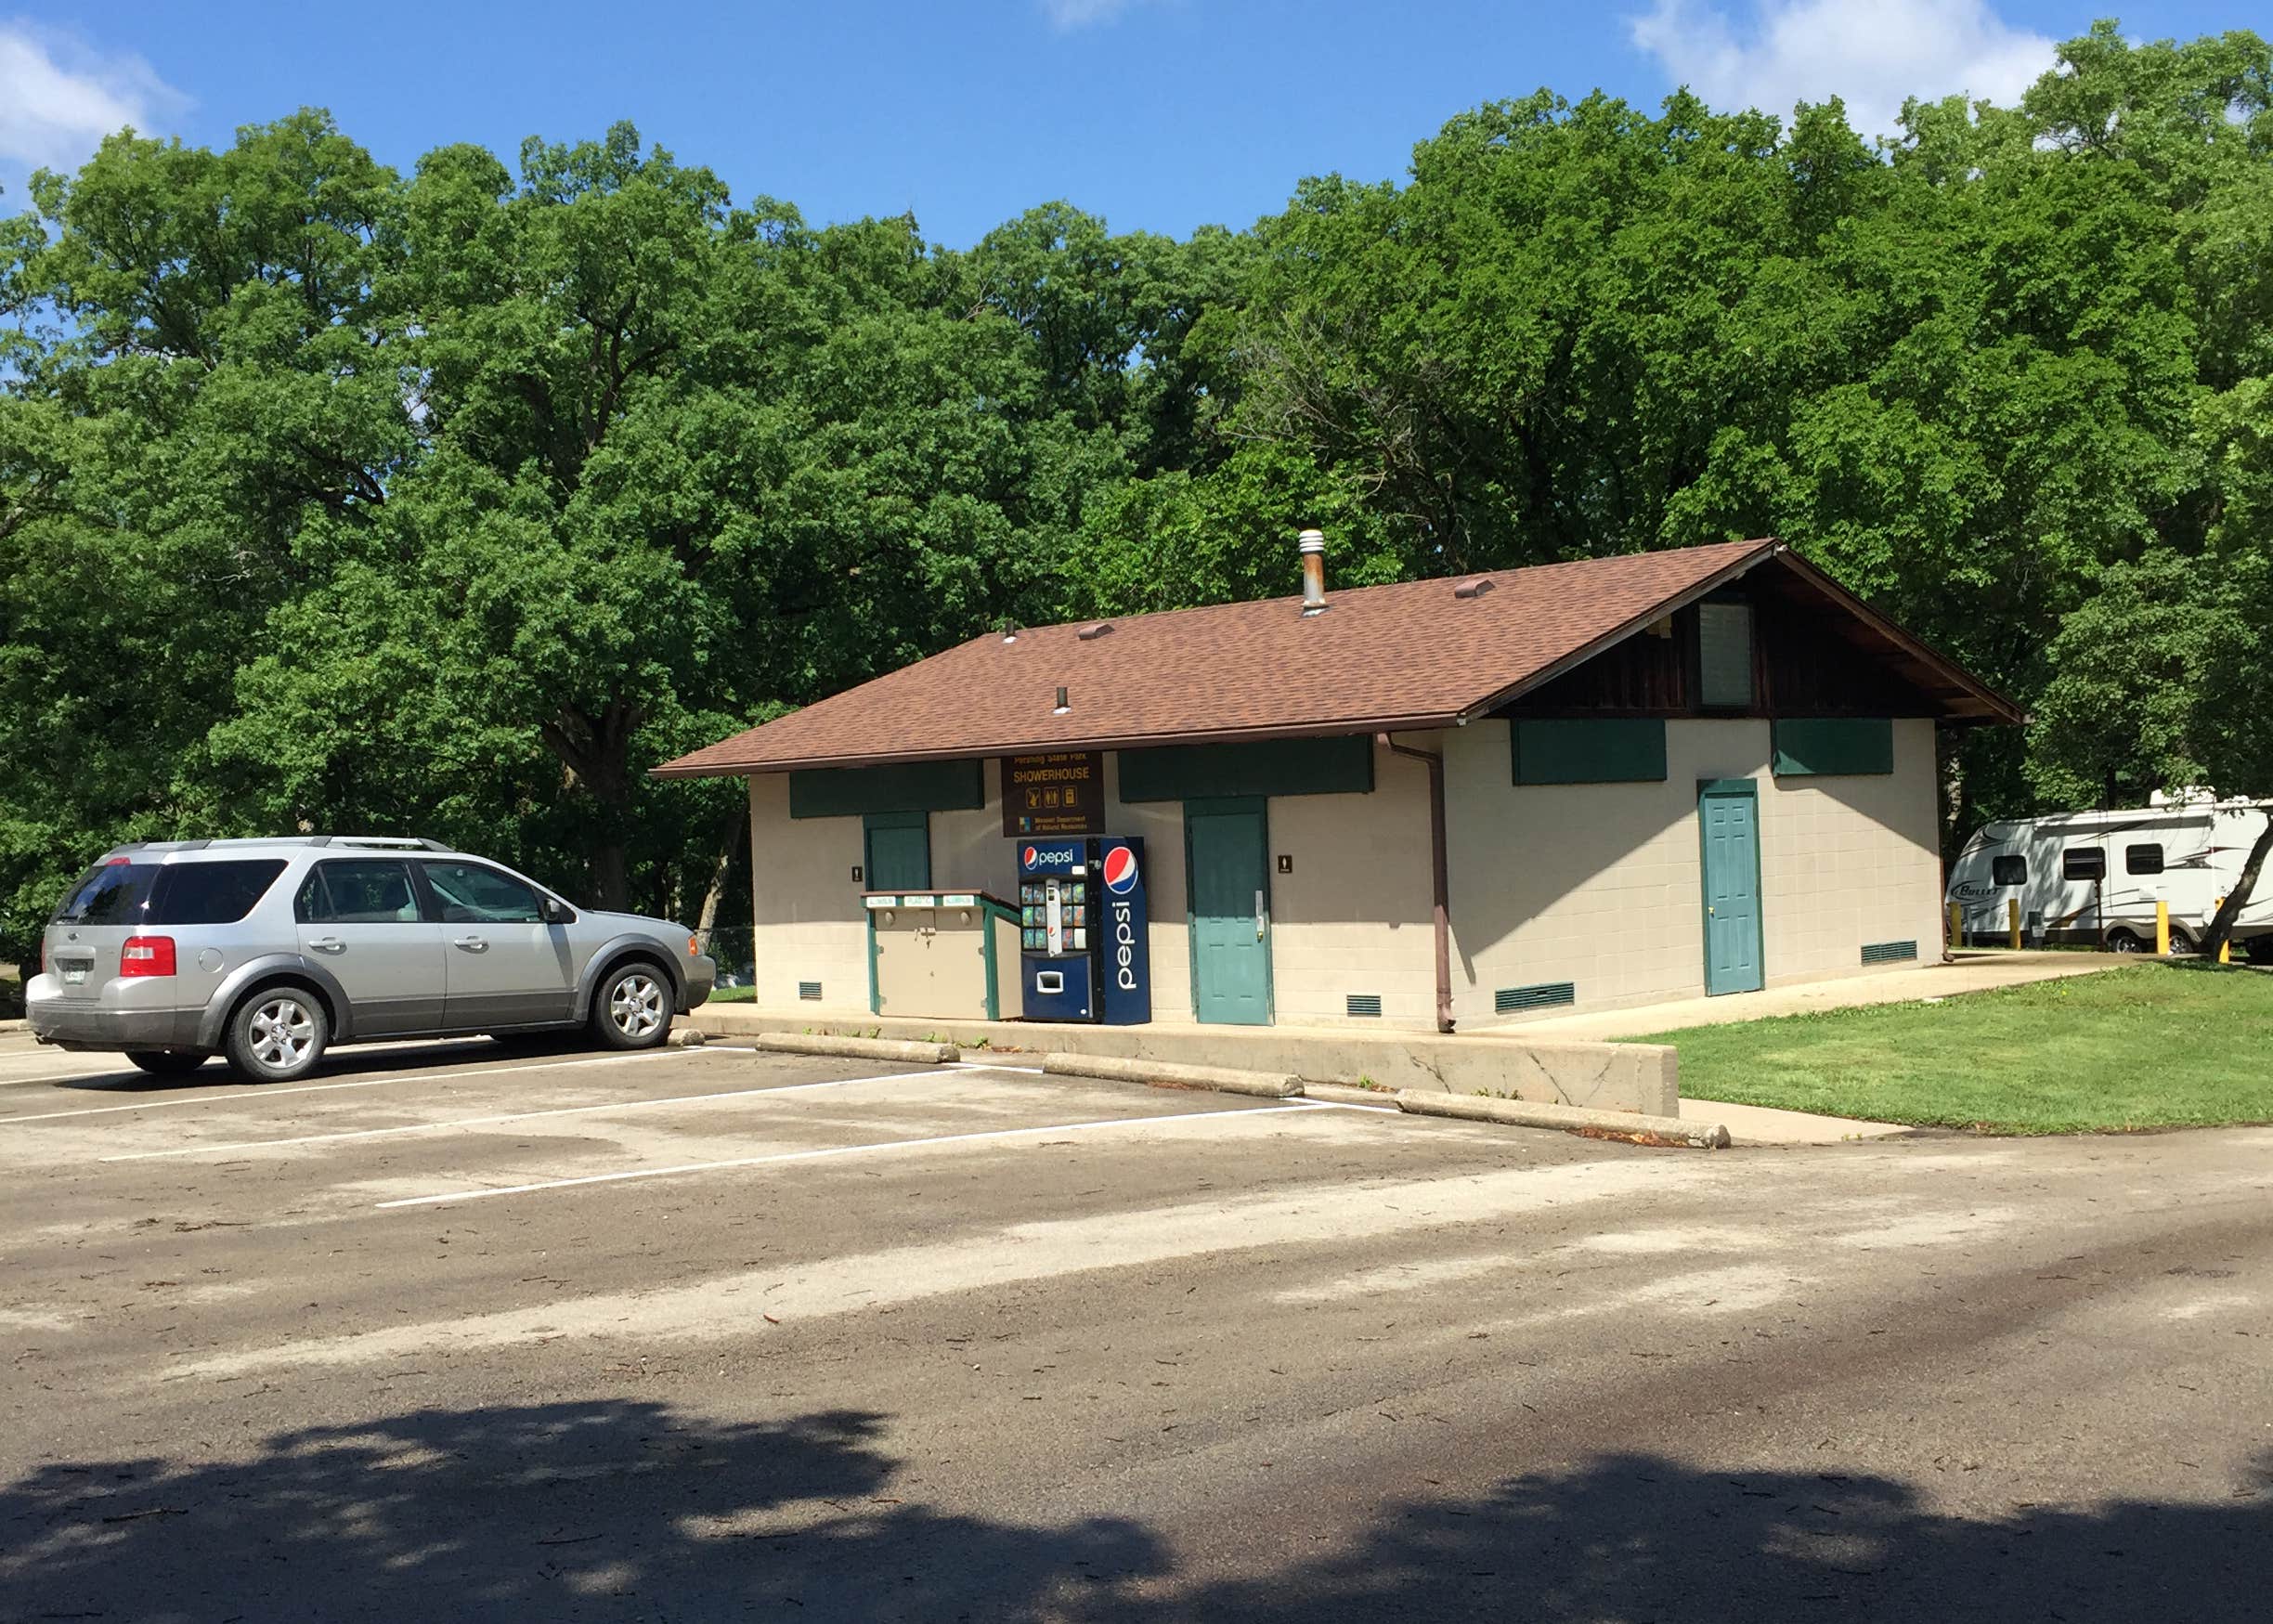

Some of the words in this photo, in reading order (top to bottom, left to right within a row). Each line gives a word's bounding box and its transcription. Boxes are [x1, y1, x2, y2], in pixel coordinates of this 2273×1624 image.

[1013, 766, 1090, 784] SHOWERHOUSE
[1039, 848, 1073, 866] pepsi
[1111, 902, 1137, 989] pepsi
